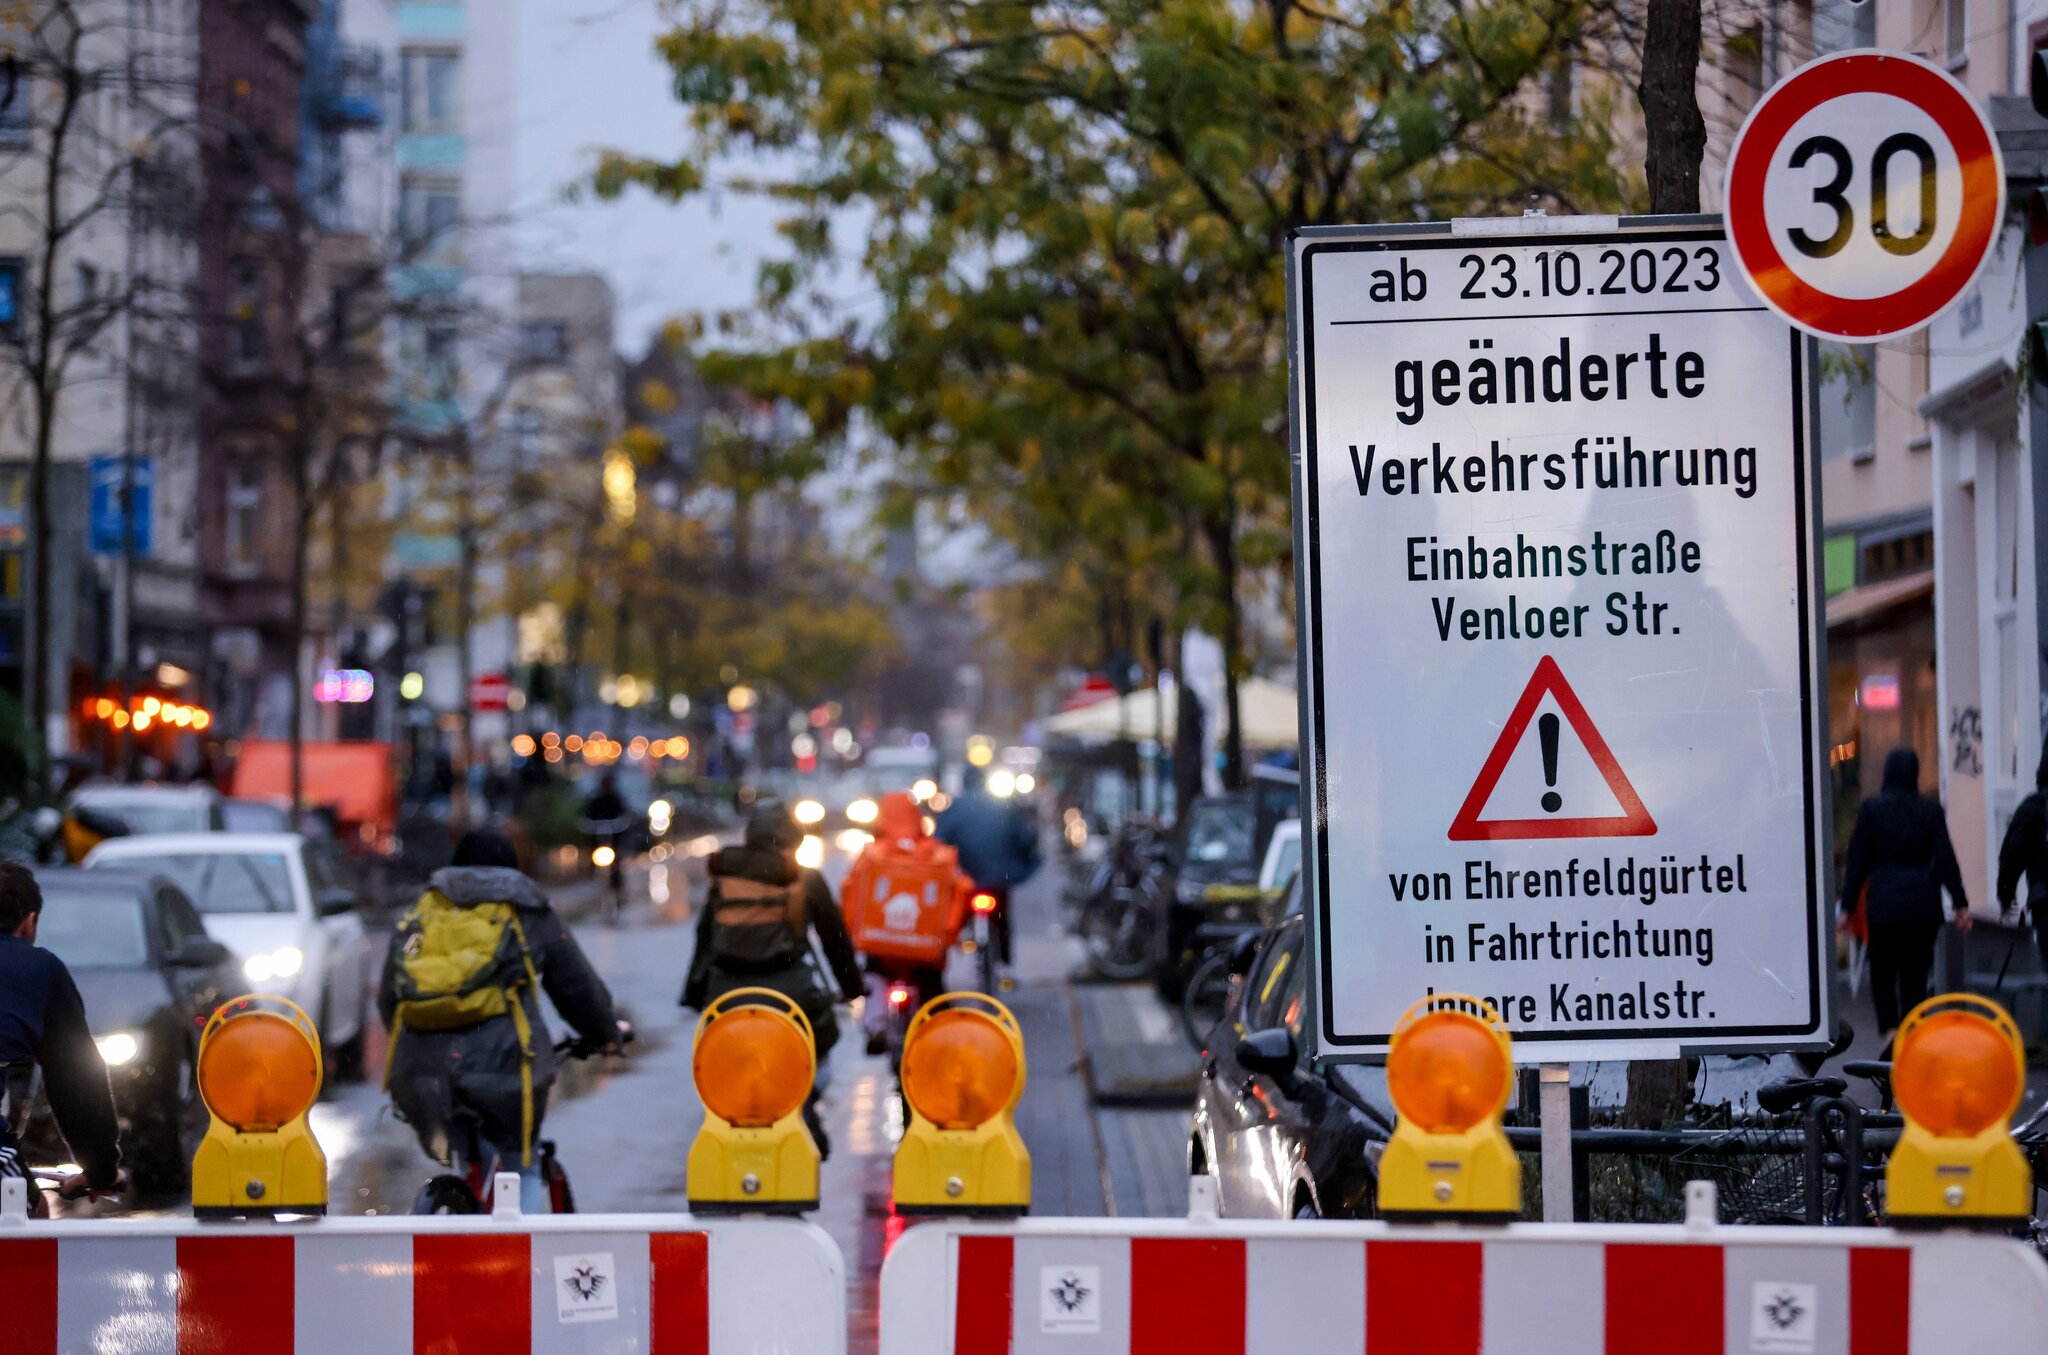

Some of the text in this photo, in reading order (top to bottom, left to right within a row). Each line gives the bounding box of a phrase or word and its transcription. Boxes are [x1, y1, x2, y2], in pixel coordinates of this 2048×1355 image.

[1788, 132, 1937, 259] 30
[1369, 246, 1720, 302] ab 23.10.2023
[1395, 333, 1705, 425] geänderte
[1349, 437, 1757, 498] Verkehrsführung
[1407, 529, 1701, 581] Einbahnstraße
[1432, 591, 1681, 641] Venloer Str.
[1389, 854, 1747, 905] von Ehrenfeldgürtel
[1425, 919, 1714, 966] in Fahrtrichtung
[1550, 980, 1716, 1022] Kanalstr.
